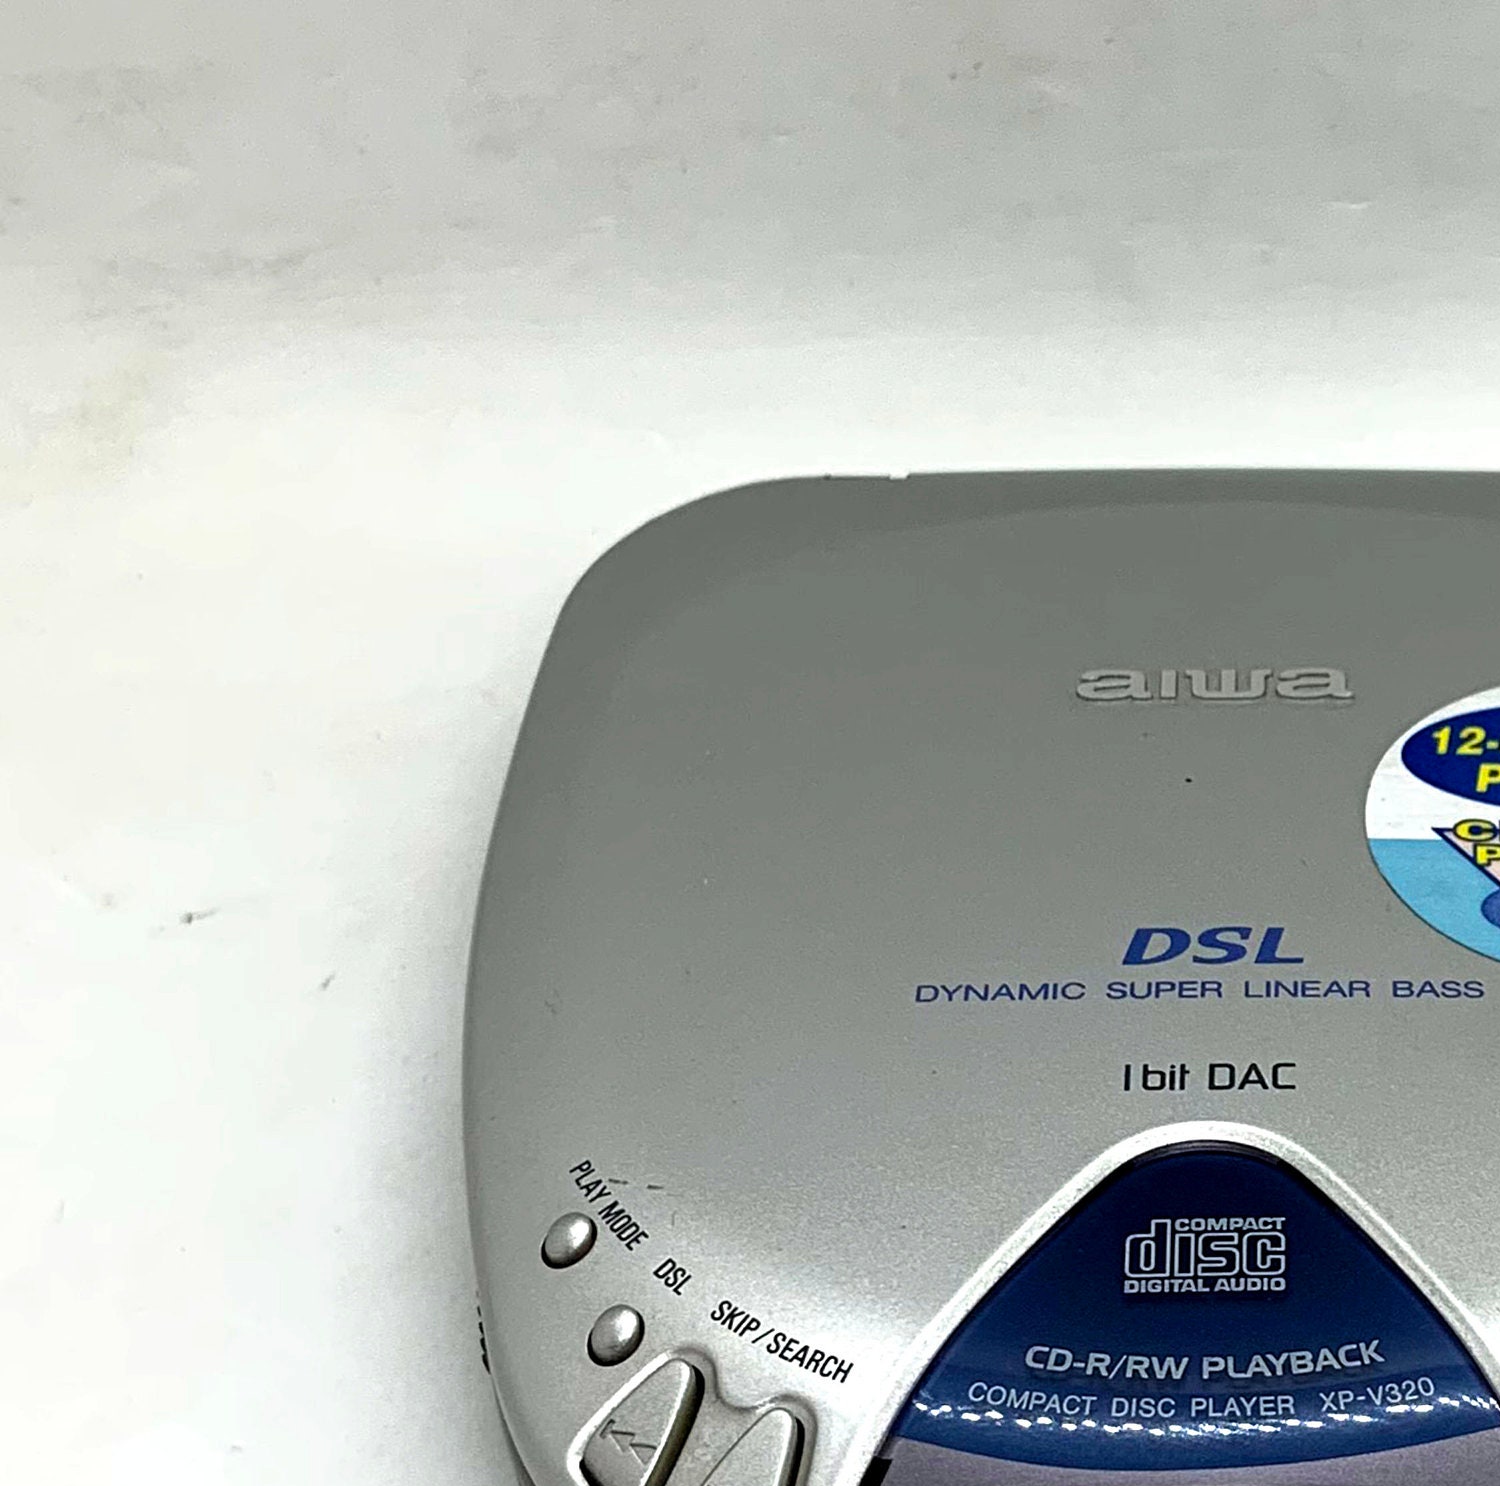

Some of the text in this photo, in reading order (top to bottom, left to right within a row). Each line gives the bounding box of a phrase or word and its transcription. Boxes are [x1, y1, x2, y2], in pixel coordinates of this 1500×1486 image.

[1074, 664, 1355, 704] aiwa
[1121, 926, 1305, 966] DSL
[915, 979, 1486, 1003] DYNAMIC SUPER LINEAR BASS
[1208, 1062, 1298, 1091] DAC
[568, 1159, 650, 1251] PLAY MODE
[1174, 1217, 1286, 1232] COMPACT
[653, 1258, 693, 1296] DSL
[1122, 1277, 1286, 1294] DIGITAL AUDIO
[710, 1300, 854, 1384] SKIP/SEARCH
[1024, 1339, 1386, 1381] CD-R/RW PLAYBACK
[967, 1376, 1436, 1419] COMPACT DISC PLAYER XP-V320
